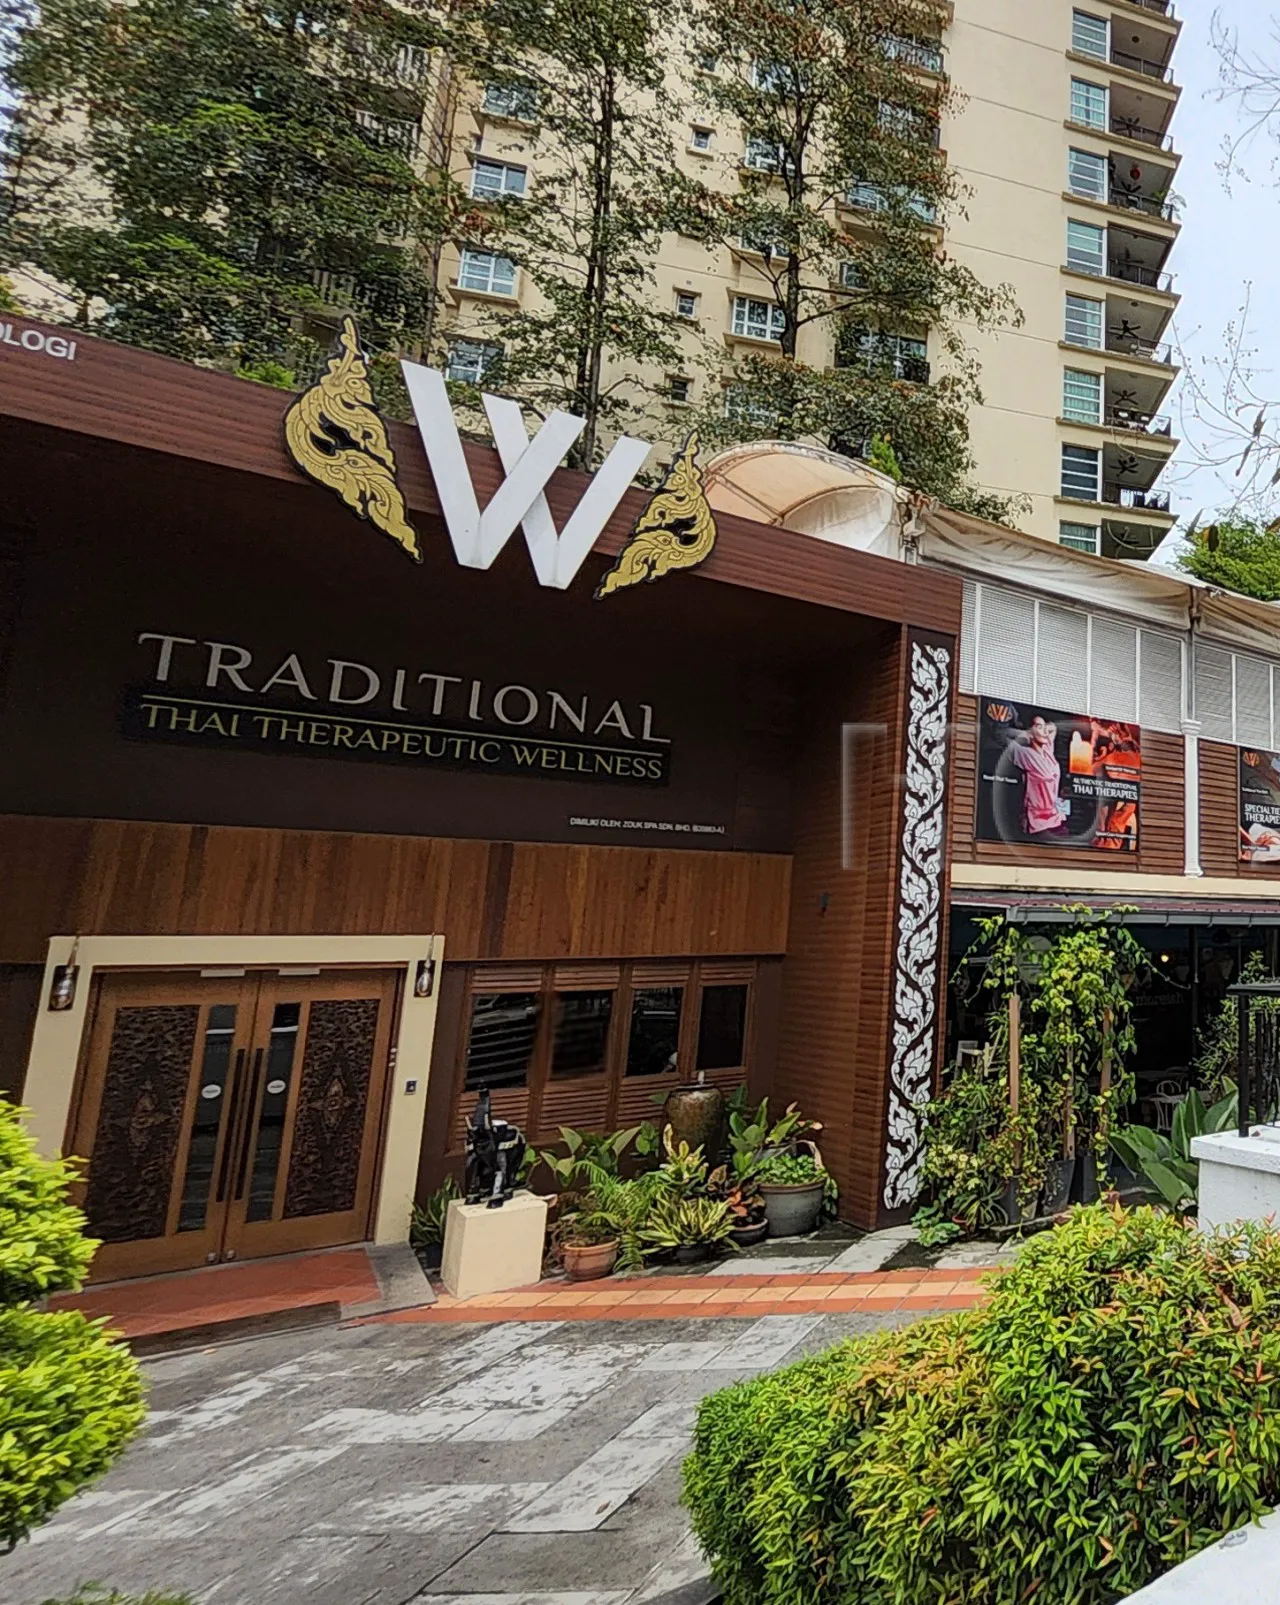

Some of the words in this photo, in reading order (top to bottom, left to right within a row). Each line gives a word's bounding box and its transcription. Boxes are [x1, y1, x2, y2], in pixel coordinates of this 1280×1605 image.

[0, 322, 77, 360] LOGI
[138, 633, 671, 743] TRADITIONAL
[140, 703, 241, 737] THAI
[252, 715, 501, 763] THERAPEUTIC
[510, 743, 663, 779] WELLNESS
[1072, 784, 1094, 795] THAI
[1095, 787, 1138, 800] THERAPIES
[1073, 777, 1104, 788] AUTHENTIC
[1104, 780, 1138, 791] TRADITIONAL
